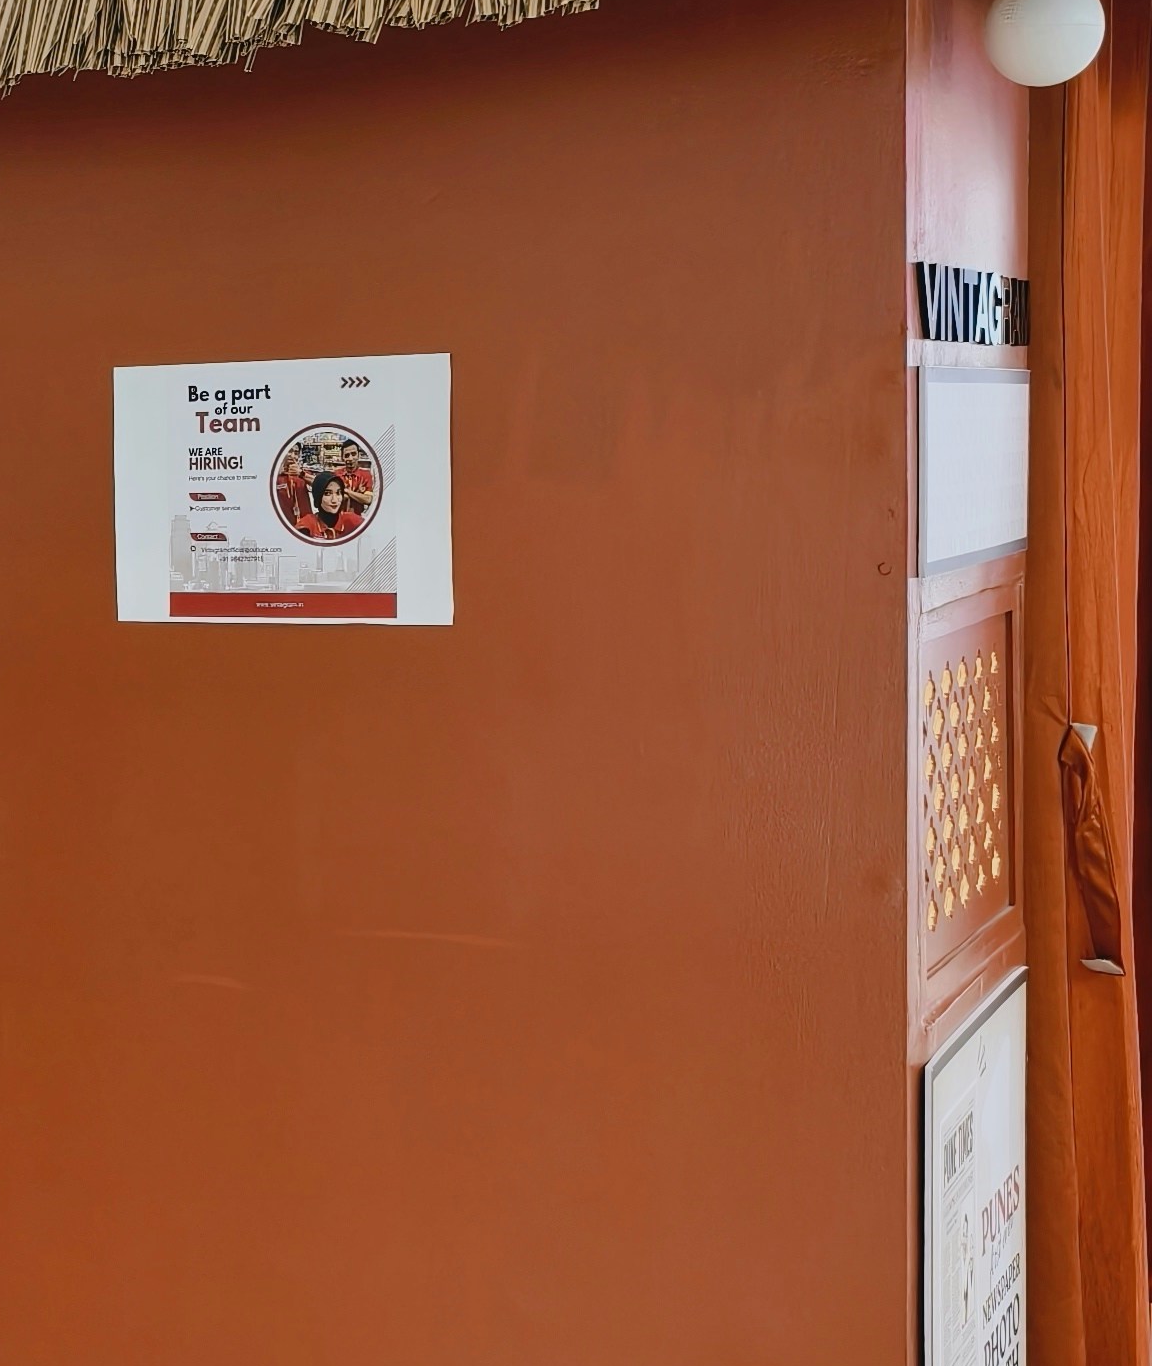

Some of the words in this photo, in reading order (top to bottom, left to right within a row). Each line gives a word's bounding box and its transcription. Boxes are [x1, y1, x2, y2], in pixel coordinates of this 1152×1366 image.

[188, 385, 209, 402] Be
[214, 390, 226, 401] a
[231, 384, 271, 405] part
[214, 402, 228, 415] of
[230, 405, 253, 414] our
[195, 411, 261, 433] Team
[188, 447, 203, 456] WE
[205, 447, 223, 456] ARE
[189, 455, 243, 470] HIRING!
[944, 1130, 957, 1189] PUNE
[958, 1110, 973, 1169] TIMES
[981, 1164, 1020, 1257] PUNES
[982, 1252, 1021, 1330] NEWSPAPER
